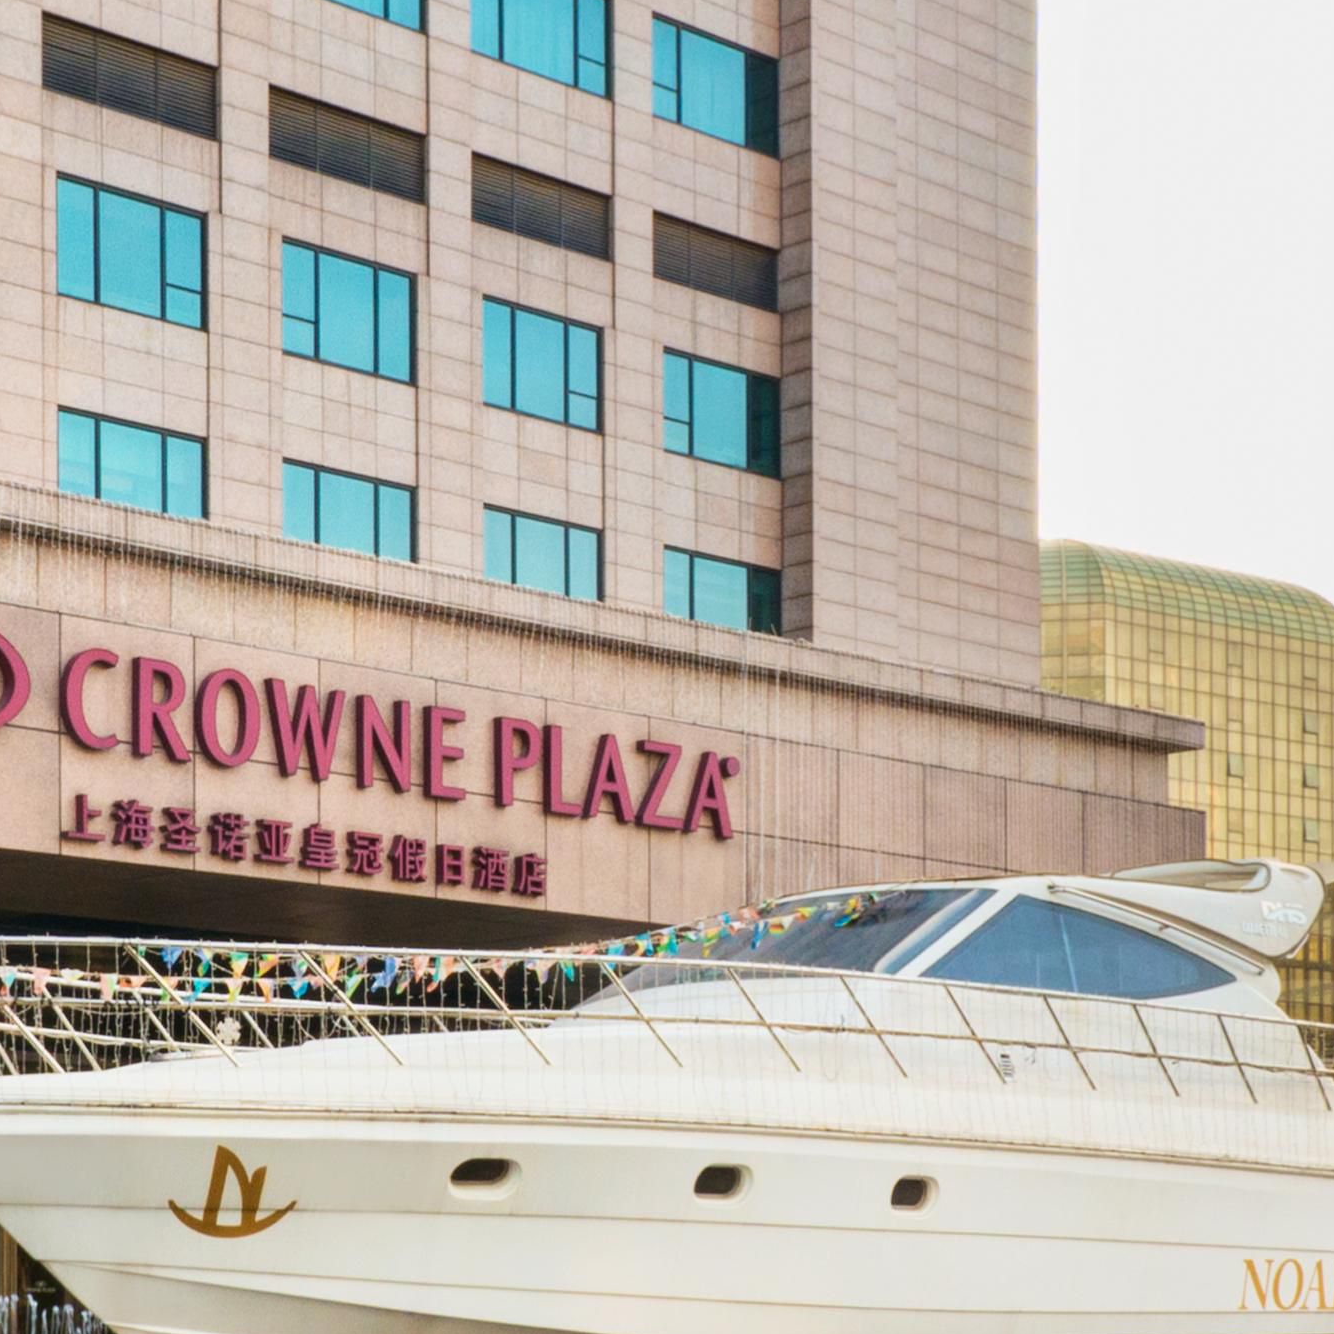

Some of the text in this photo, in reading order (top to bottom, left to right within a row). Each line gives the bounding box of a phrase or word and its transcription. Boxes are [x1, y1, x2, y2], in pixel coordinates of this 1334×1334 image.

[62, 647, 737, 839] CROWNE PLAZA
[61, 794, 548, 896] 上海圣诺亚皇冠假日酒店
